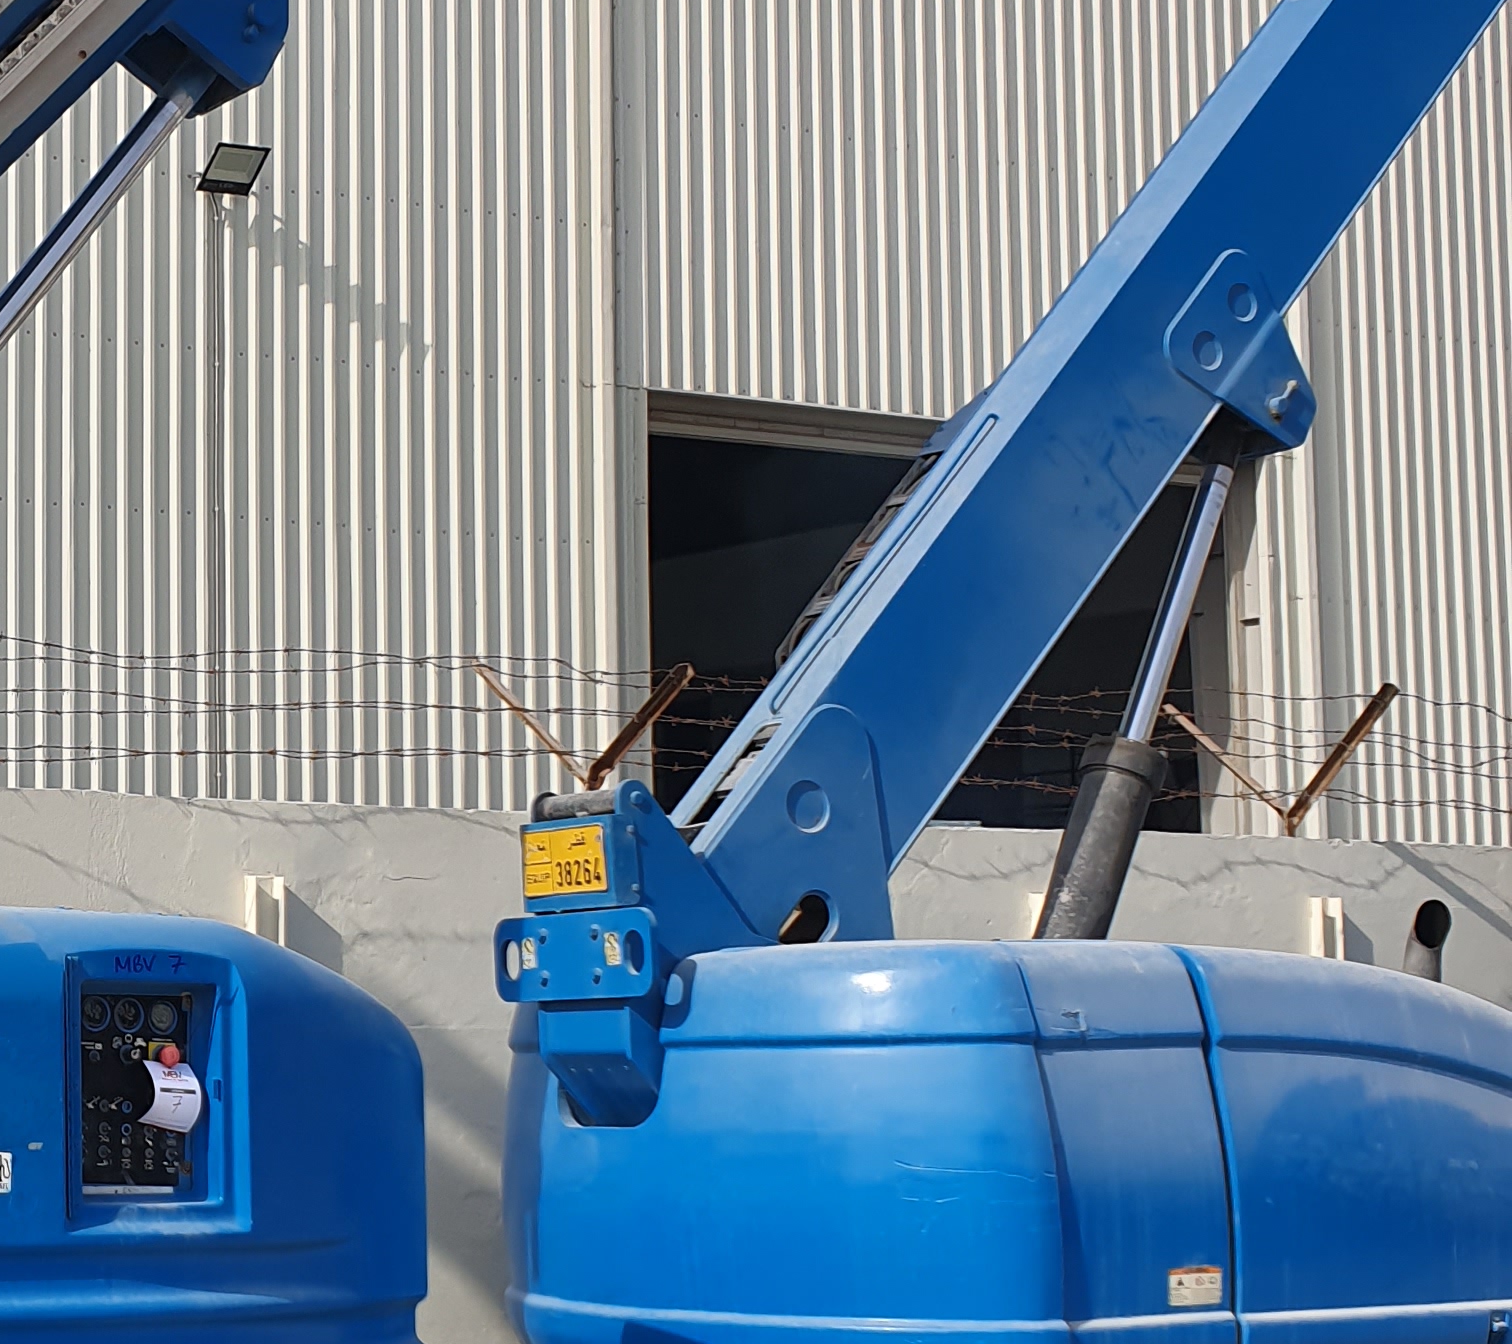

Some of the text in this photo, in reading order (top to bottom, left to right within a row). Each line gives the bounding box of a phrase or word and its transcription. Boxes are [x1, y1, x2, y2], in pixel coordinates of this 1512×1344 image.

[554, 857, 602, 888] 38264
[113, 953, 187, 975] MBV 7
